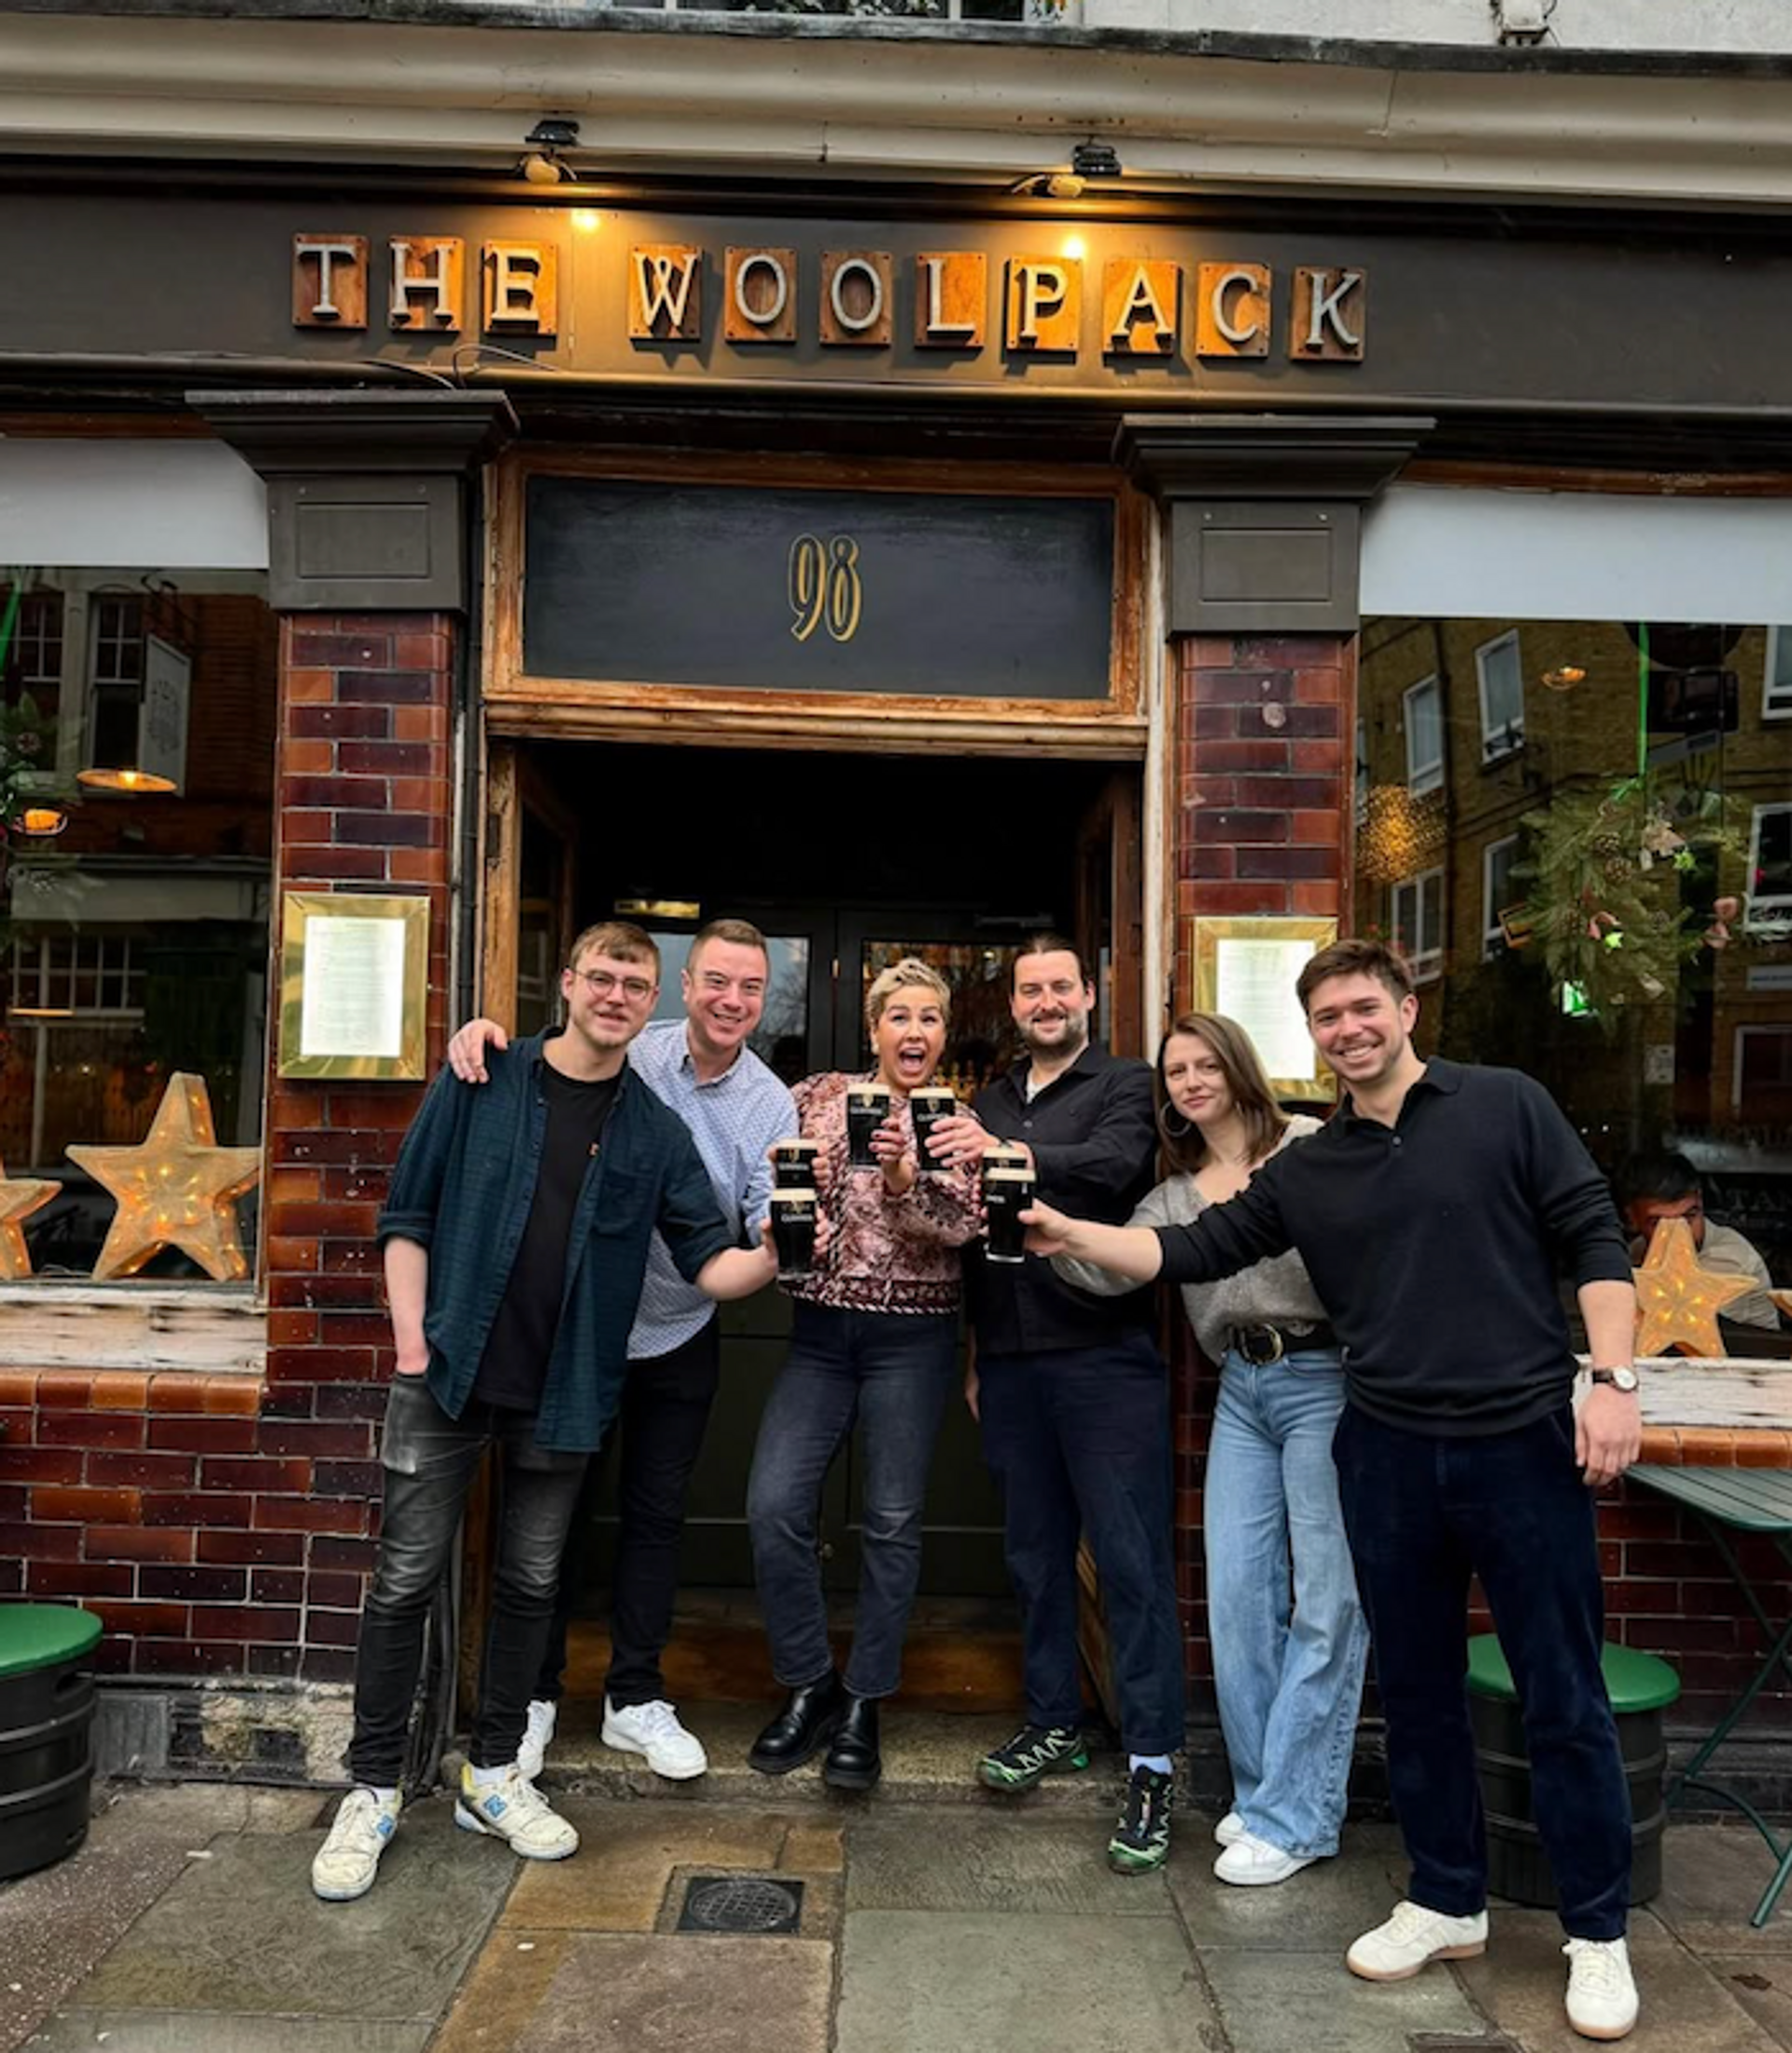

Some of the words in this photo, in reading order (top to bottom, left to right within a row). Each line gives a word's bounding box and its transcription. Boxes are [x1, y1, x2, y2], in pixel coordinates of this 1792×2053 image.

[295, 242, 542, 326] THE
[632, 252, 1362, 351] WOOLPACK
[789, 533, 861, 641] 98
